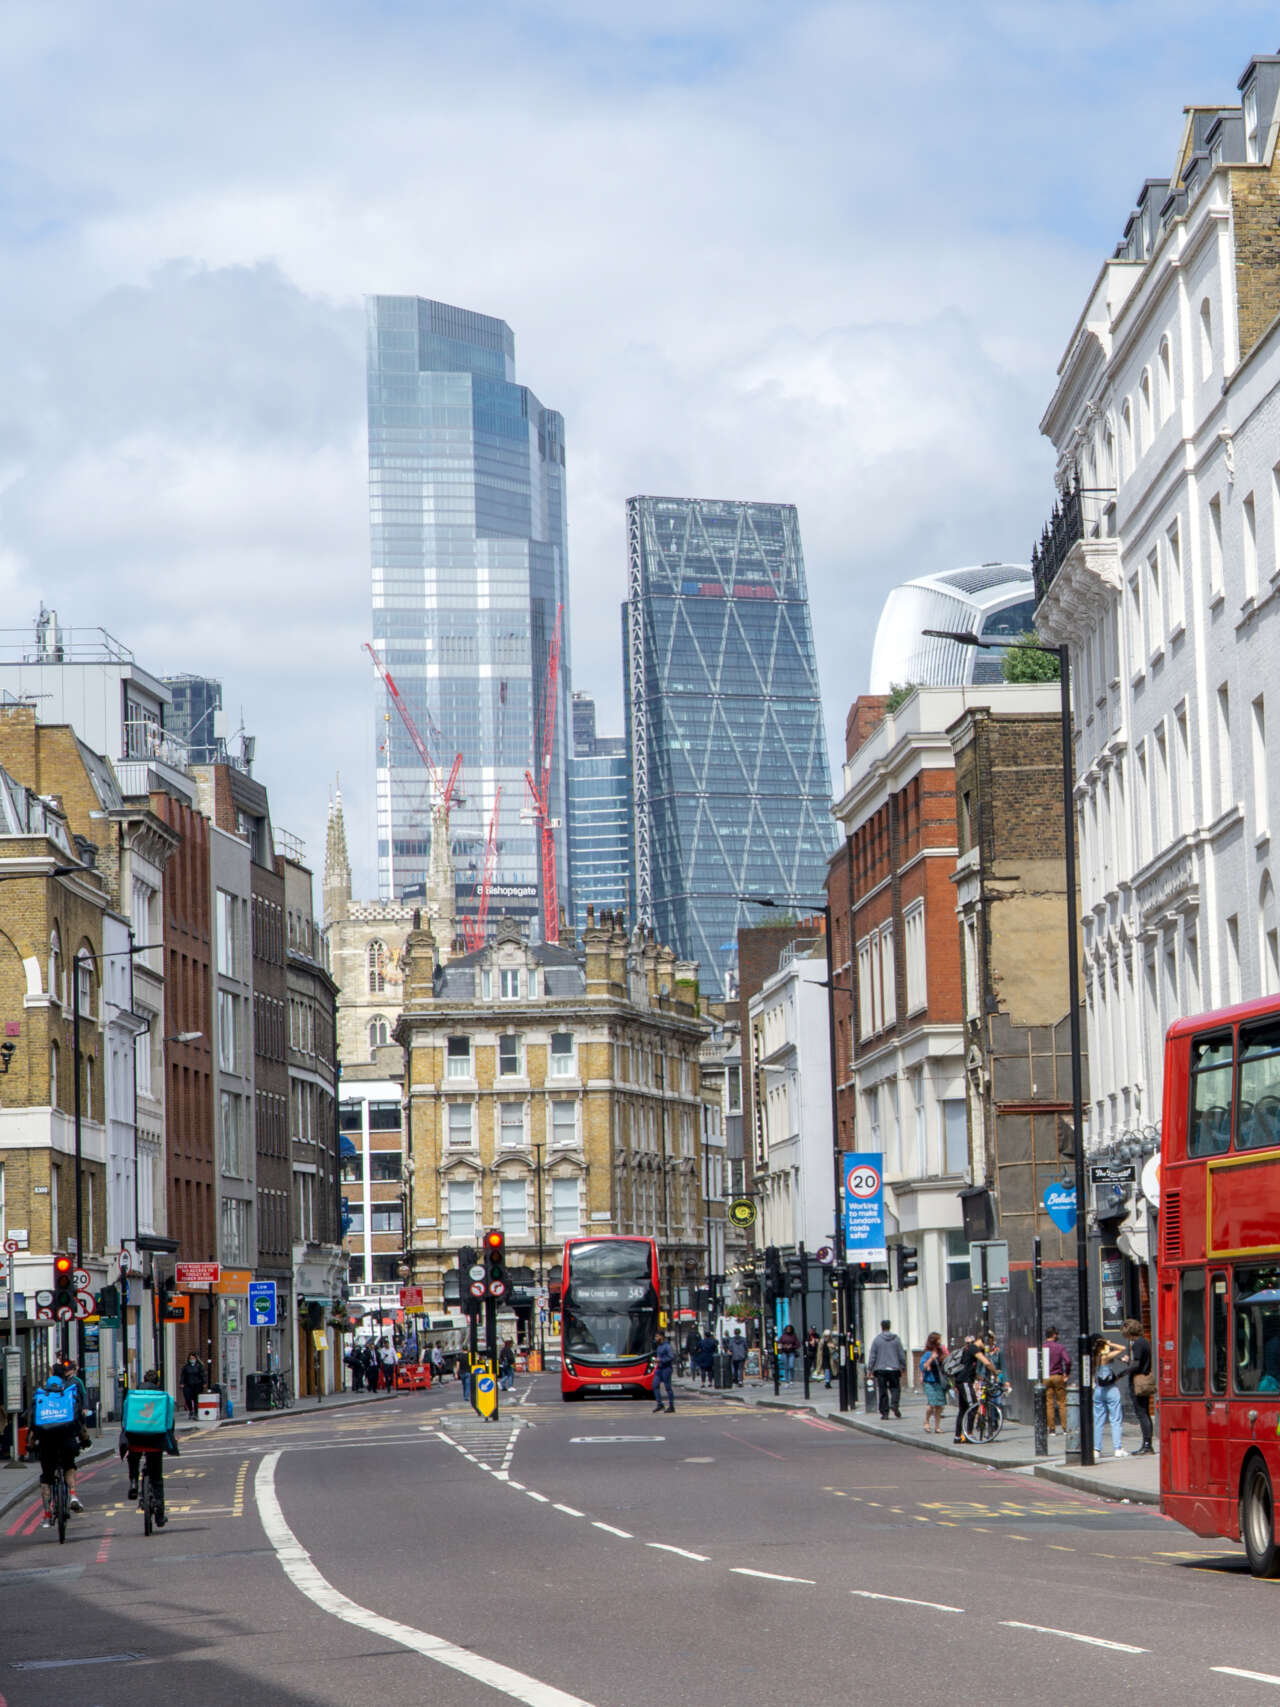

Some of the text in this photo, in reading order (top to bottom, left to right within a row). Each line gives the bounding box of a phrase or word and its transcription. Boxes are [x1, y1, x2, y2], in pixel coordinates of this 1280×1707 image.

[485, 885, 537, 896] Bishopsgate
[853, 1175, 876, 1188] 20
[848, 1202, 879, 1211] Working
[849, 1217, 881, 1225] London's
[72, 1274, 88, 1284] 20
